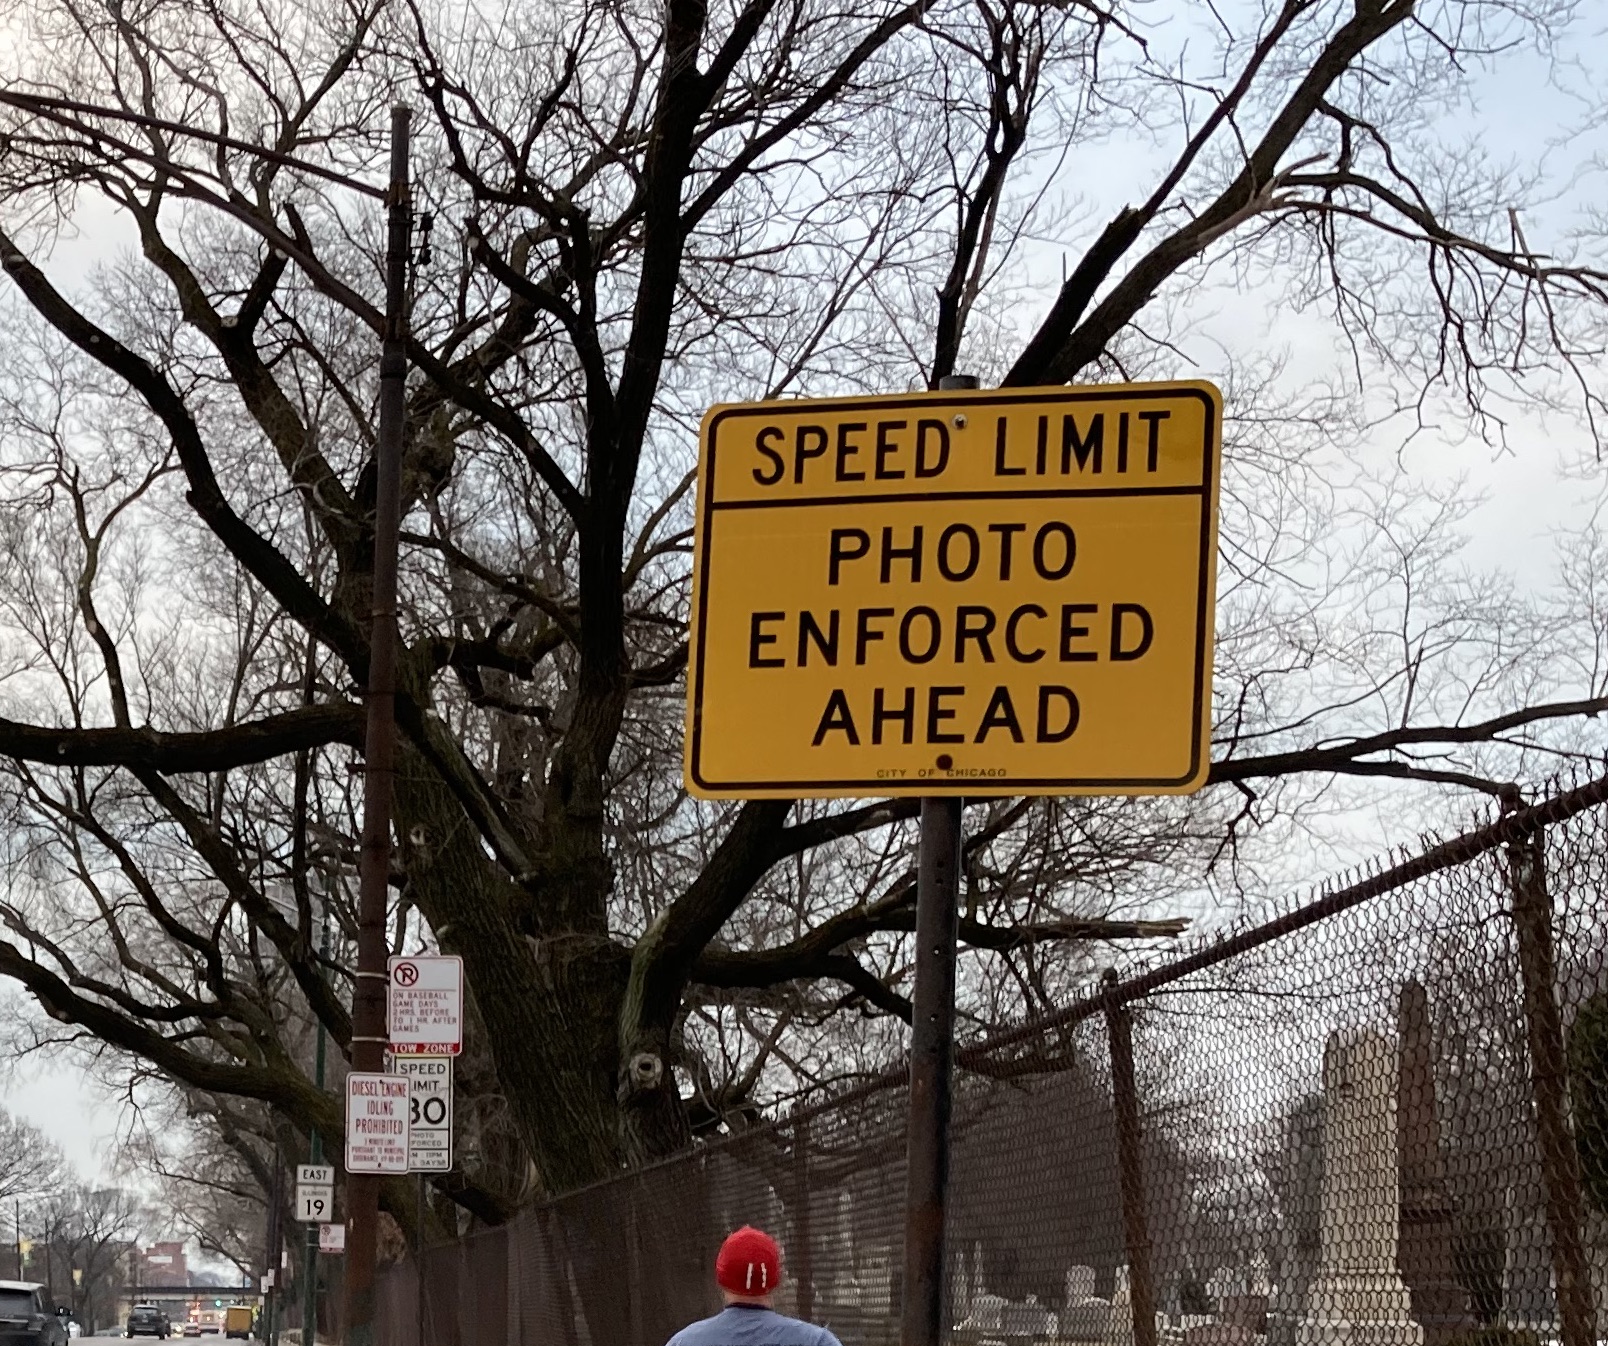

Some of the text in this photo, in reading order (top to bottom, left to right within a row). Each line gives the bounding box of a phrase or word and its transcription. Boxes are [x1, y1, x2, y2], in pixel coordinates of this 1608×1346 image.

[752, 410, 1172, 487] SPEED LIMIT
[828, 520, 1077, 586] PHOTO
[748, 602, 1155, 669] ENFORCED
[810, 684, 1082, 747] AHEAD
[876, 768, 1007, 778] CITY OF CHICAGO
[407, 992, 449, 1000] BASEBALL
[393, 1000, 439, 1008] GAME DAYS
[420, 1008, 450, 1016] BEFORE
[432, 1017, 457, 1025] AFTER
[393, 1043, 454, 1053] TOW ZONE
[399, 1063, 446, 1075] SPEED
[352, 1080, 407, 1098] DIESEL ENGINE
[412, 1080, 440, 1092] IMIT
[367, 1100, 394, 1116] IDLING
[411, 1096, 447, 1125] 30
[355, 1118, 404, 1135] PROHIBITED
[303, 1169, 328, 1180] EAST
[306, 1199, 325, 1216] 19
